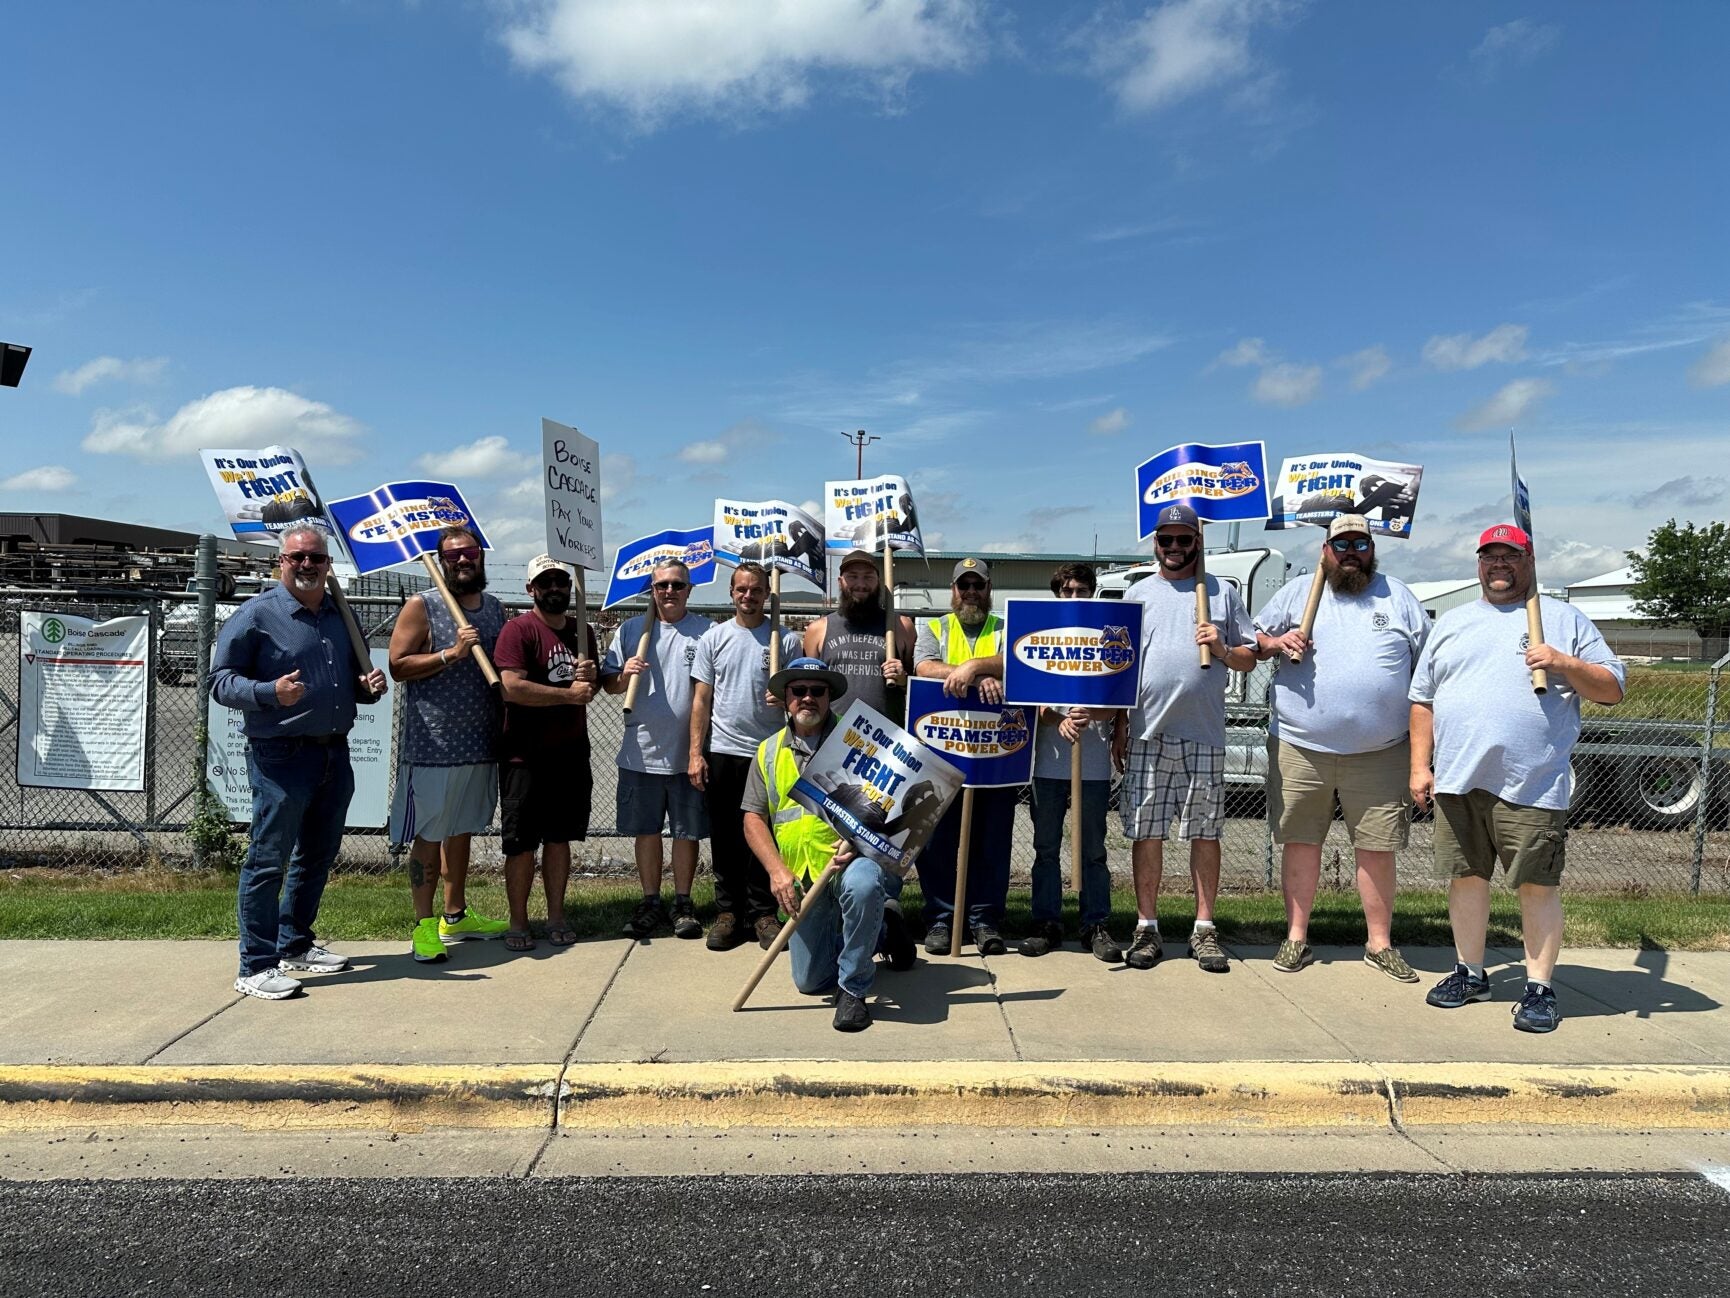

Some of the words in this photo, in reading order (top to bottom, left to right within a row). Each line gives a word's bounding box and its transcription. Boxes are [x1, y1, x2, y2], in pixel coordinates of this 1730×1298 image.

[214, 458, 236, 469] It's
[237, 458, 258, 469] Our
[260, 455, 294, 469] Union
[1290, 463, 1307, 472] It's
[1309, 461, 1329, 470] Our
[1331, 460, 1363, 471] Union
[219, 470, 257, 483] We'll
[1155, 468, 1218, 488] BUILDING
[238, 470, 300, 499] FIGHT
[1151, 476, 1258, 499] TEAMSTER
[1296, 474, 1355, 494] FIGHT
[833, 488, 849, 497] It's
[852, 487, 868, 496] Our
[1169, 486, 1225, 499] POWER
[723, 506, 739, 515] It's
[742, 508, 758, 517] Our
[761, 507, 787, 517] Union
[845, 495, 893, 521] FIGHT
[363, 504, 428, 528] BULDING
[1296, 511, 1334, 520] TEAMSTERS
[360, 509, 468, 539] TEAMSTER
[387, 519, 442, 540] POWER
[734, 520, 783, 539] FIGHT
[1369, 520, 1384, 528] ONE
[907, 535, 915, 543] AS
[629, 549, 682, 565] BUILDING
[774, 556, 793, 565] STAND
[794, 559, 801, 568] AS
[67, 628, 87, 637] Boise
[827, 637, 838, 649] IN
[838, 634, 851, 645] MY
[1030, 635, 1099, 646] BUILDING
[841, 650, 858, 660] WAS
[860, 650, 878, 659] LEFT
[1023, 646, 1133, 662] TEAMSTER
[1046, 660, 1103, 671] POWER
[930, 715, 996, 729] BUILDING
[924, 725, 1028, 743] TEAMSTER
[352, 738, 380, 746] departing
[842, 728, 878, 758] We'll
[852, 715, 873, 736] It's
[871, 727, 895, 749] Our
[892, 742, 923, 773] Union
[944, 740, 999, 753] POWER
[367, 747, 383, 755] Entry
[226, 767, 237, 775] No
[842, 747, 907, 797] FIGHT
[225, 784, 236, 793] No
[860, 781, 885, 804] For
[822, 797, 859, 831] TEAMSTERS
[856, 825, 880, 846] STAND
[877, 840, 890, 853] AS
[887, 847, 902, 860] ONE
